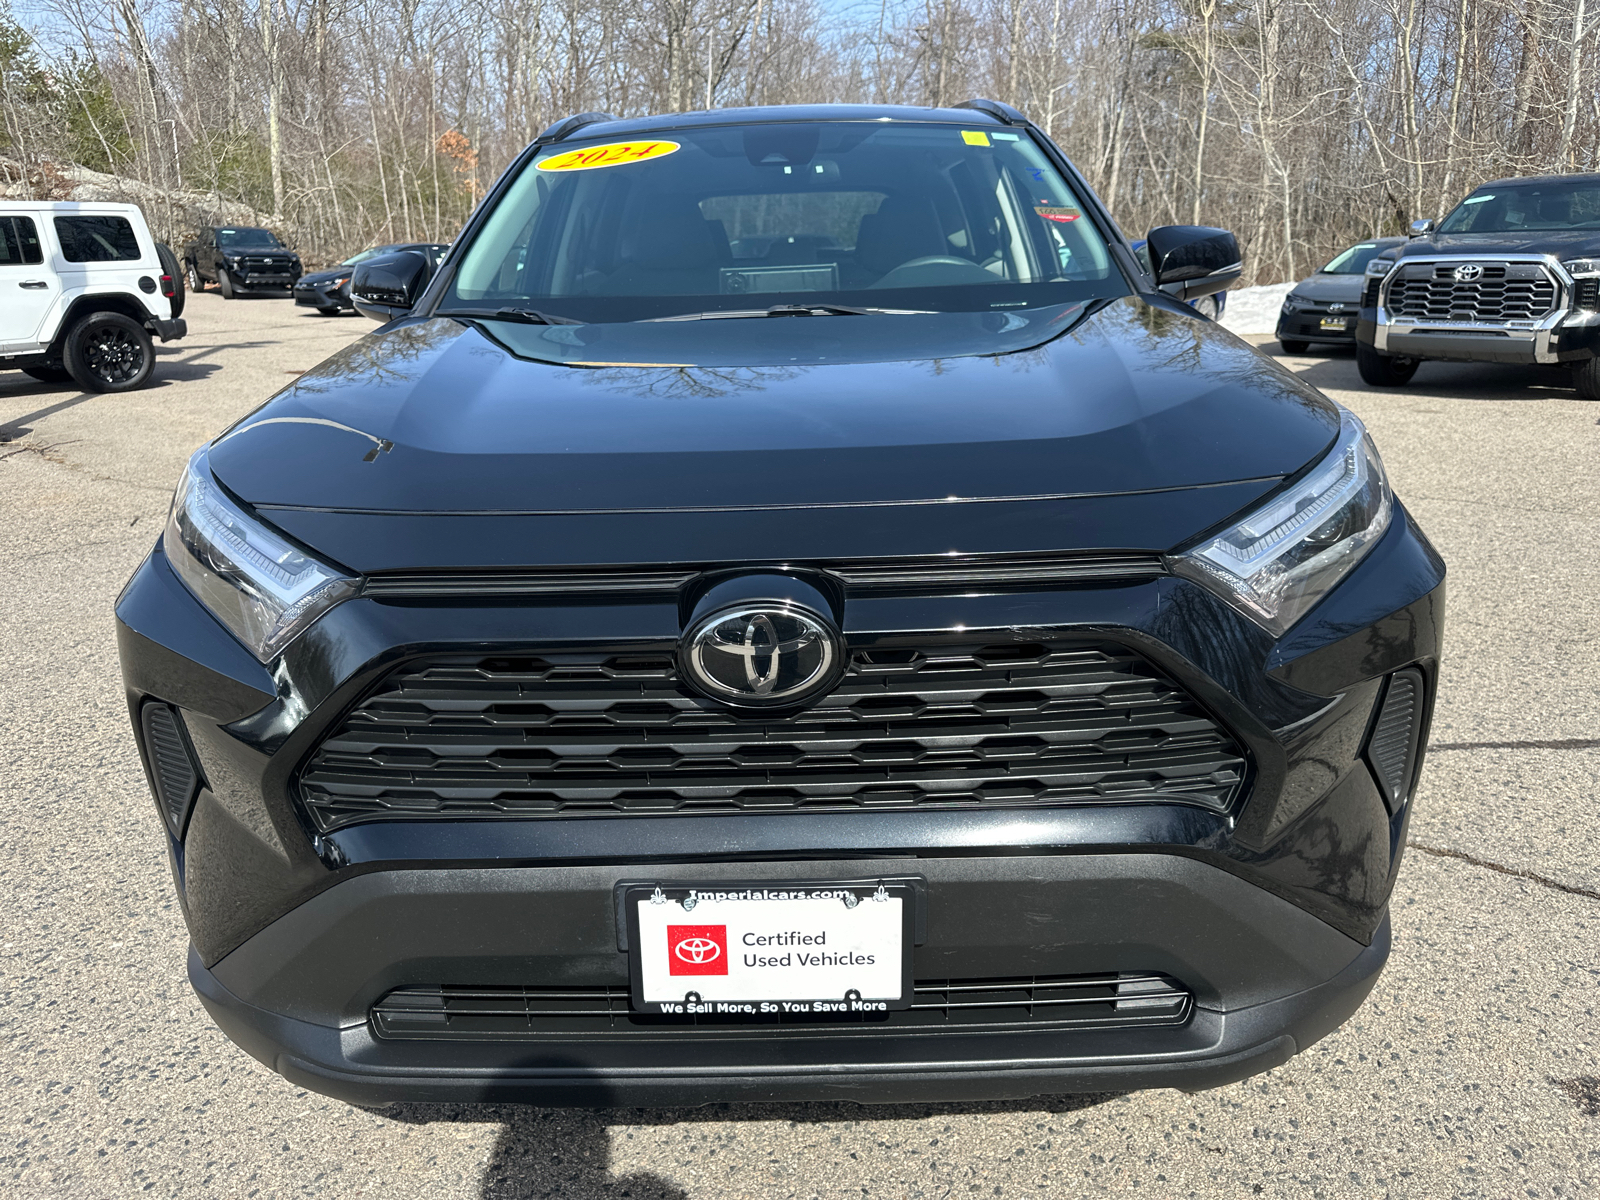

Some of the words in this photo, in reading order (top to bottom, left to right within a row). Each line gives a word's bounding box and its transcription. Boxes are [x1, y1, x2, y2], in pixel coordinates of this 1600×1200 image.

[555, 143, 660, 169] 2024
[689, 889, 850, 903] Imperialcars.com
[742, 931, 826, 946] Certified
[743, 952, 792, 967] Used
[797, 952, 875, 966] Vehicles
[660, 1003, 683, 1013] We
[687, 1003, 713, 1013] Sell
[717, 1003, 756, 1015] More,
[760, 1002, 778, 1013] So
[782, 1002, 809, 1012] You
[813, 1001, 847, 1012] Save
[851, 1001, 887, 1011] More
